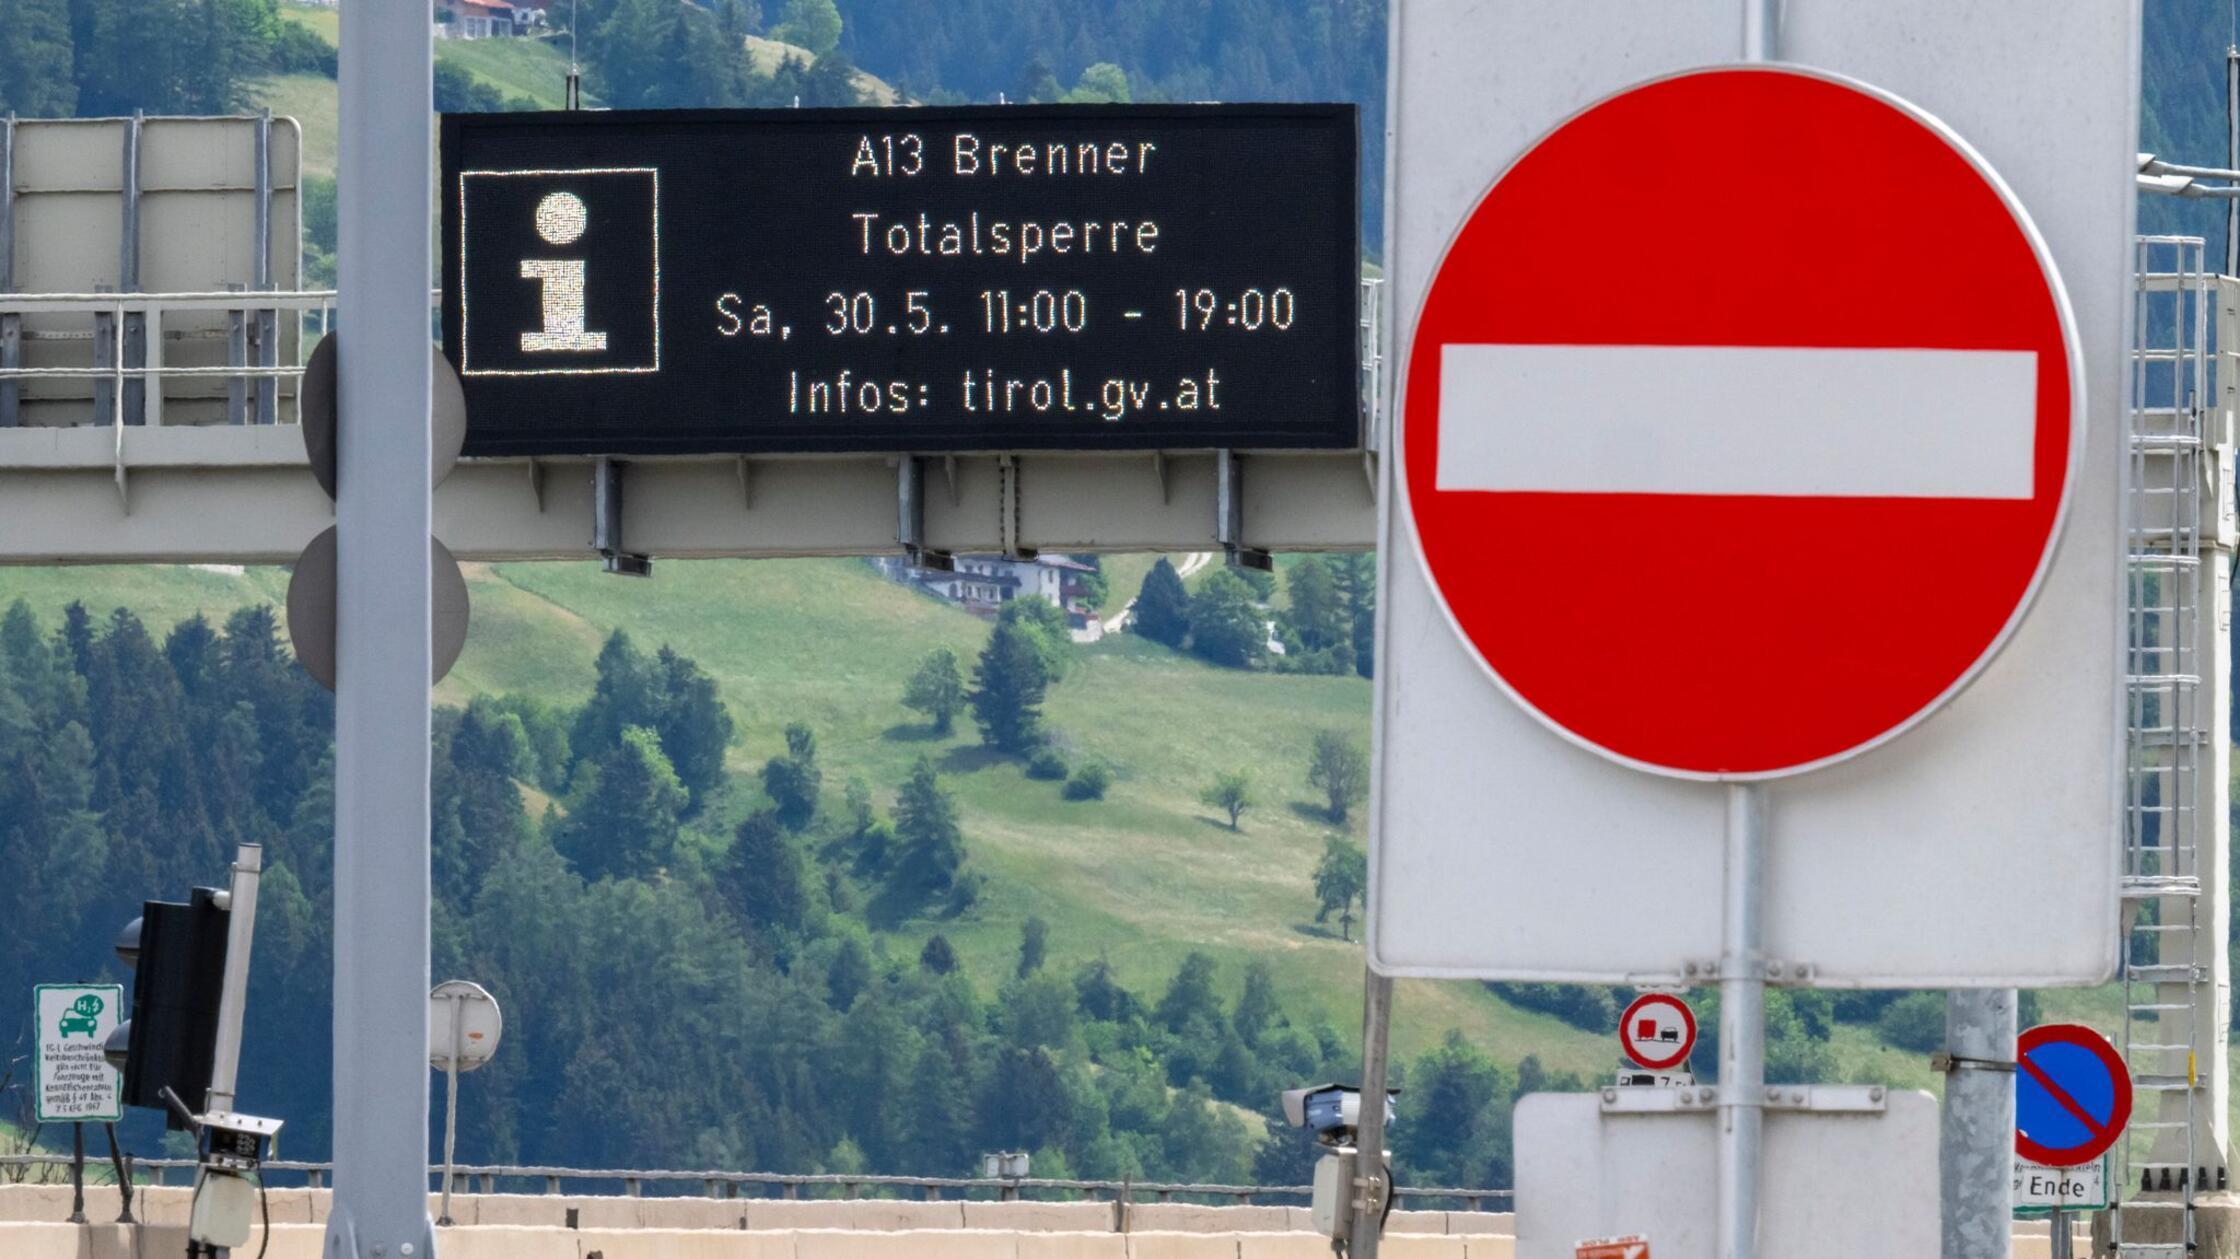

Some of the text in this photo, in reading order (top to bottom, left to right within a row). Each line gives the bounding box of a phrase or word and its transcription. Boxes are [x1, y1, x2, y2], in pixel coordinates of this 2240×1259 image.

[852, 134, 1157, 177] A13 Brenner
[851, 212, 1159, 264] Totalsperre
[716, 292, 791, 341] Sa,
[825, 291, 949, 335] 30.5.
[980, 289, 1086, 334] 11:00
[1175, 287, 1295, 331] 19:00
[790, 367, 1220, 421] Infos: tirol.gv.at
[2030, 1175, 2085, 1198] Ende
